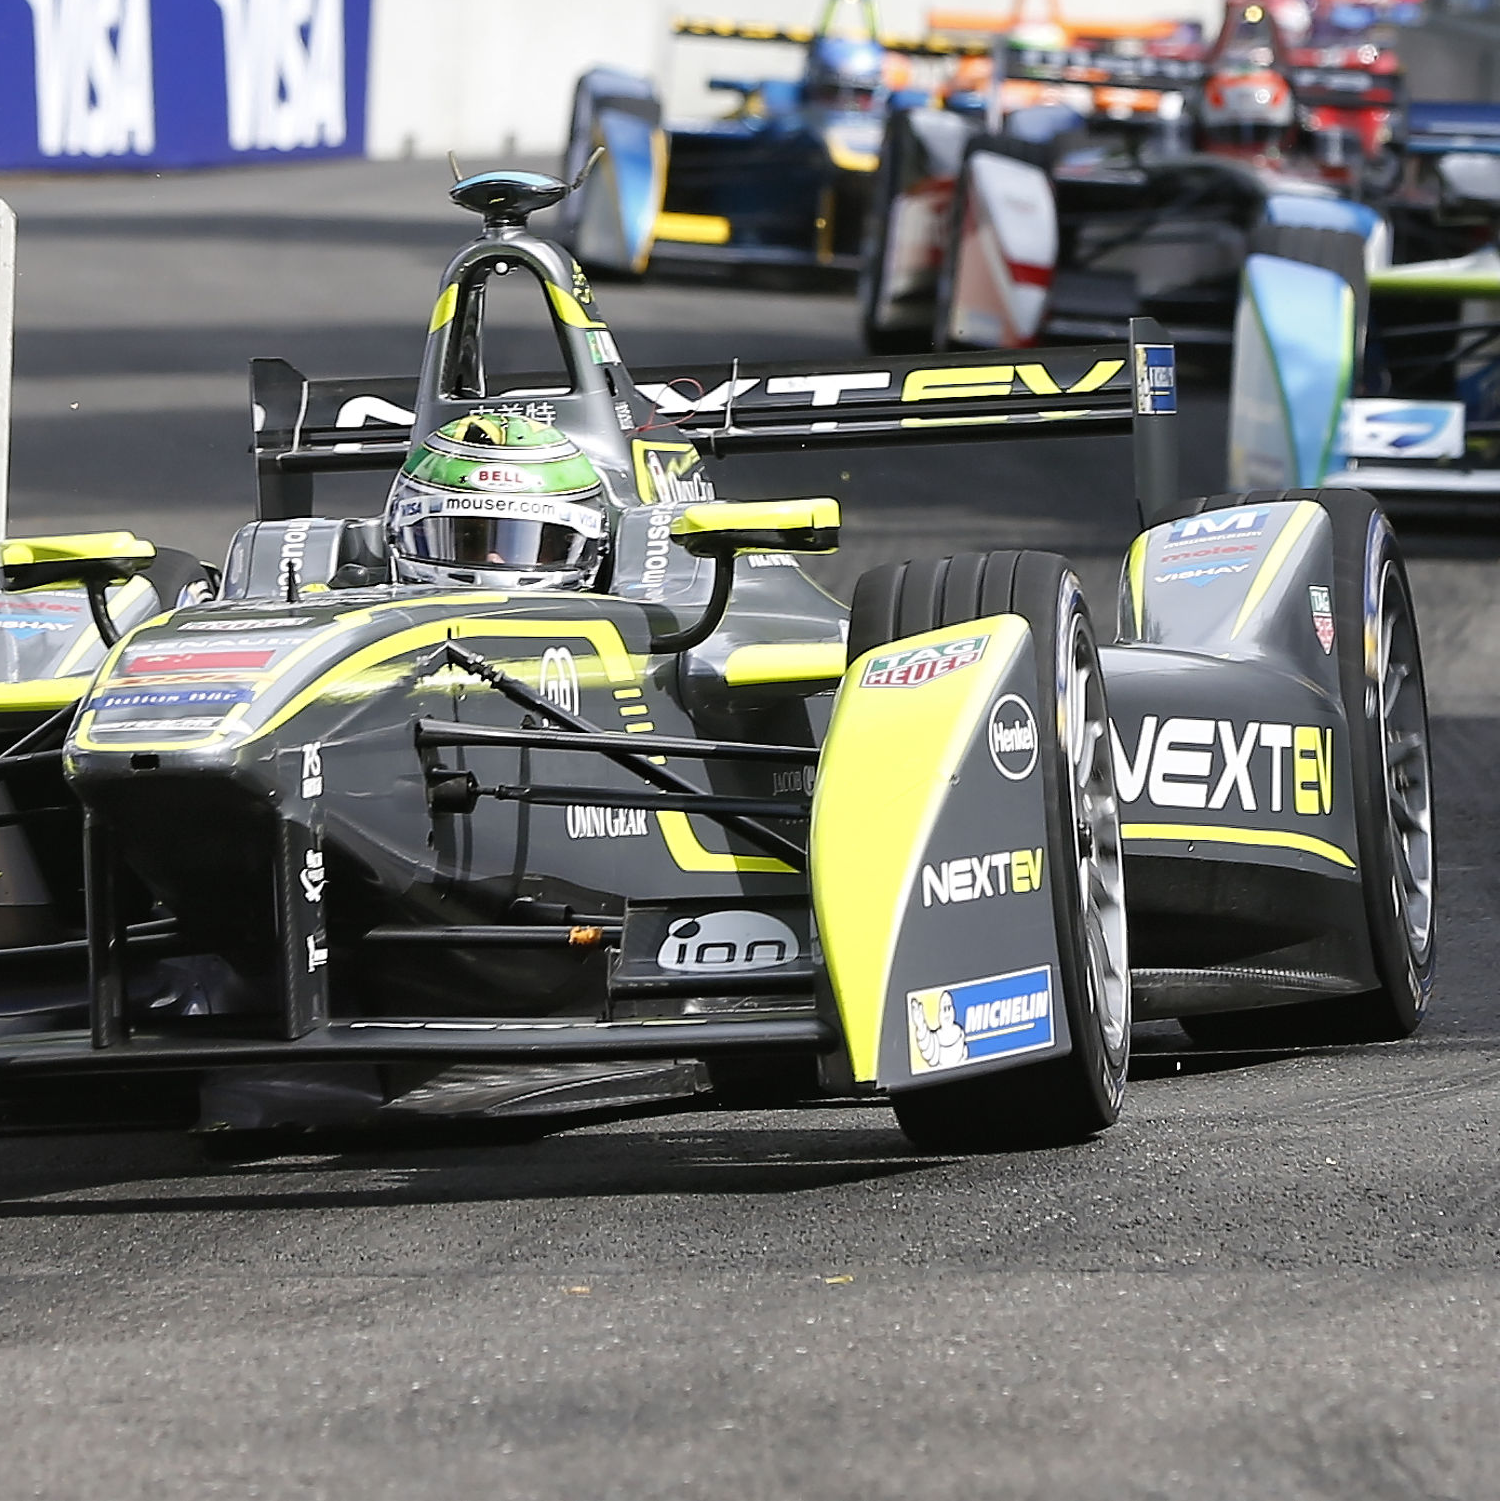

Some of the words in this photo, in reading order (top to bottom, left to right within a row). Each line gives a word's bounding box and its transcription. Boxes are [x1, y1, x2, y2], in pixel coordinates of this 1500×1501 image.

[478, 470, 524, 484] BELL
[446, 496, 556, 516] mouser.com
[1161, 544, 1258, 563] molex
[1154, 563, 1250, 583] VISHAY
[868, 652, 976, 685] HEUER
[878, 639, 977, 670] TAG
[993, 719, 1034, 753] Henkel
[922, 847, 1044, 907] NEXTEV
[964, 990, 1049, 1034] MICHELIN
